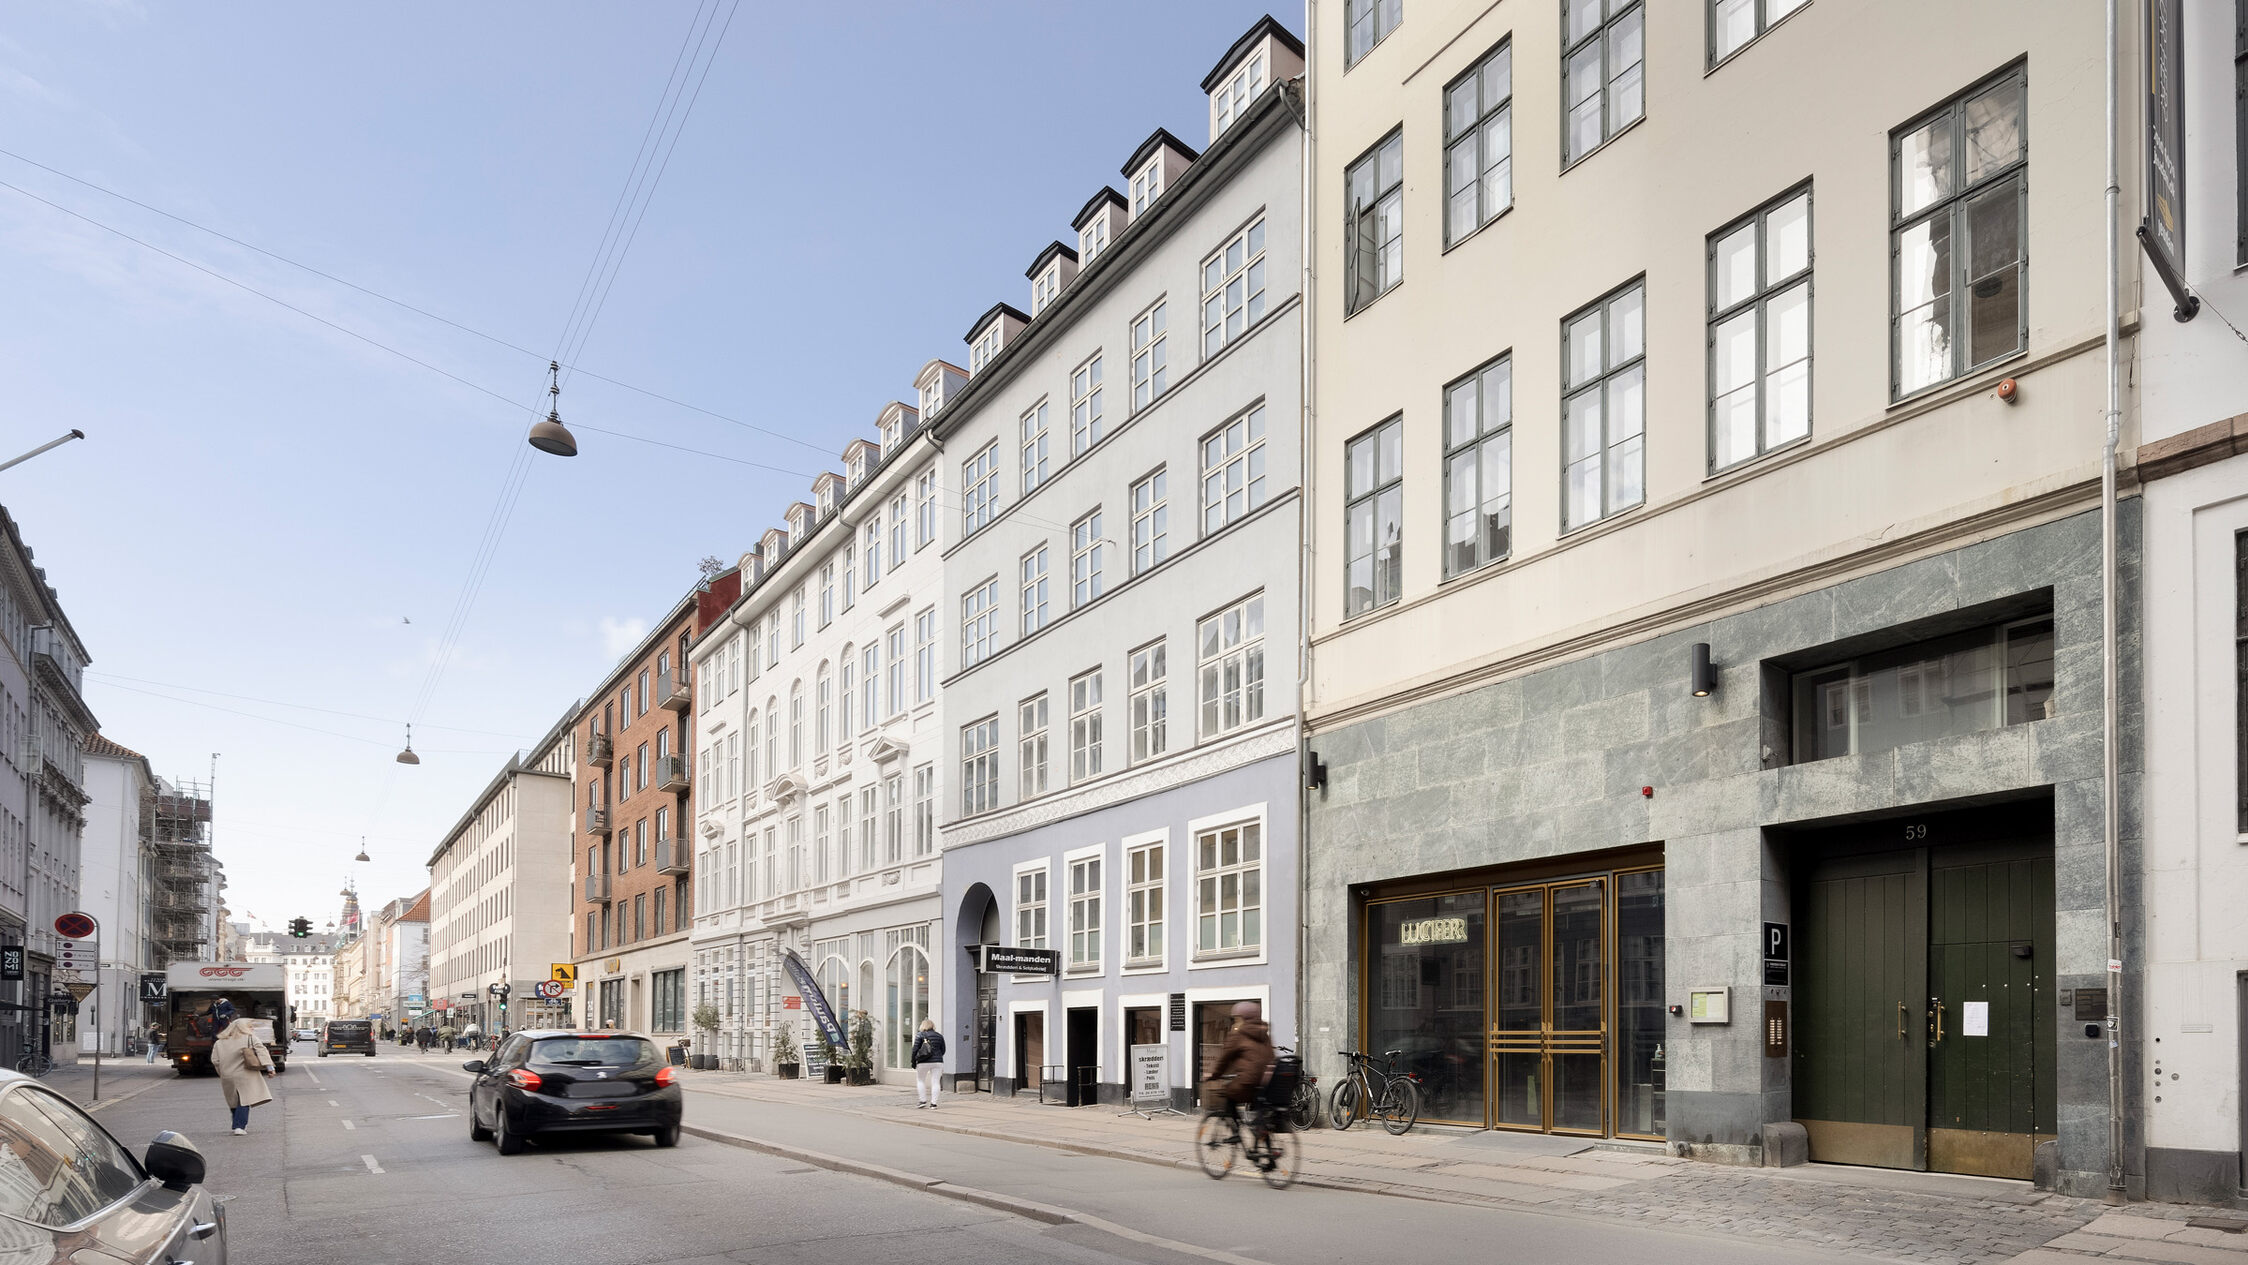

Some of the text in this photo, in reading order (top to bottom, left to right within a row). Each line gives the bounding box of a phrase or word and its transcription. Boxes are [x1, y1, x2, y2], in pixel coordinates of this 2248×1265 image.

[1905, 824, 1927, 841] 59
[1401, 918, 1468, 943] LUCIFER
[1771, 928, 1781, 955] P
[991, 953, 1051, 964] Maal-manden
[147, 982, 167, 996] M
